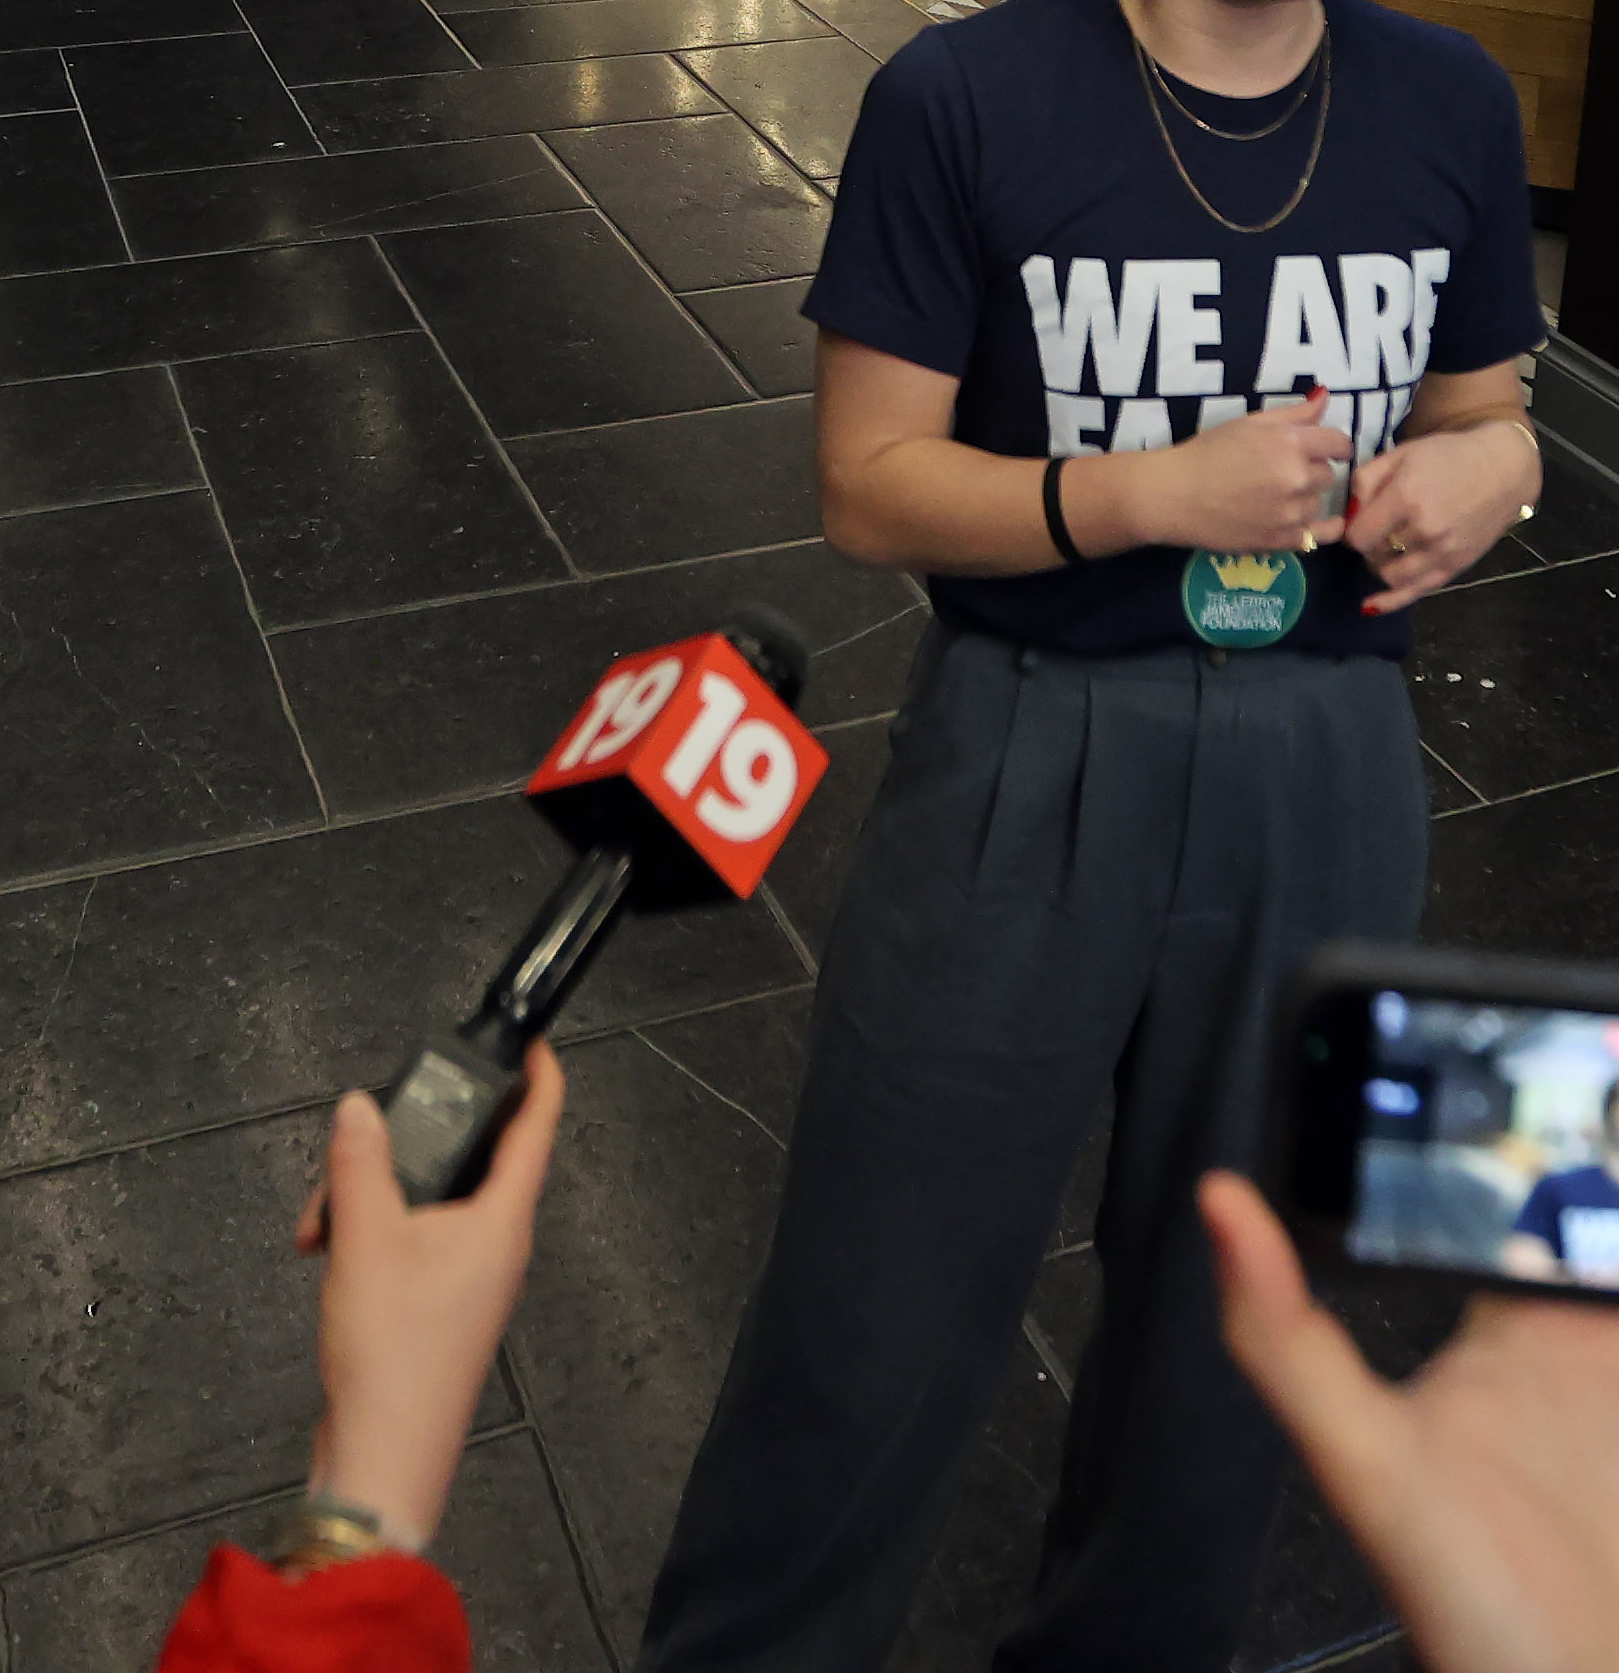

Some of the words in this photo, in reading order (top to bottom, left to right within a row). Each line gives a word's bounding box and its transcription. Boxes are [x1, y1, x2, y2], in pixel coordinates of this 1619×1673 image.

[1021, 254, 1225, 397] WE
[556, 656, 684, 772] 19
[662, 671, 799, 843] 19
